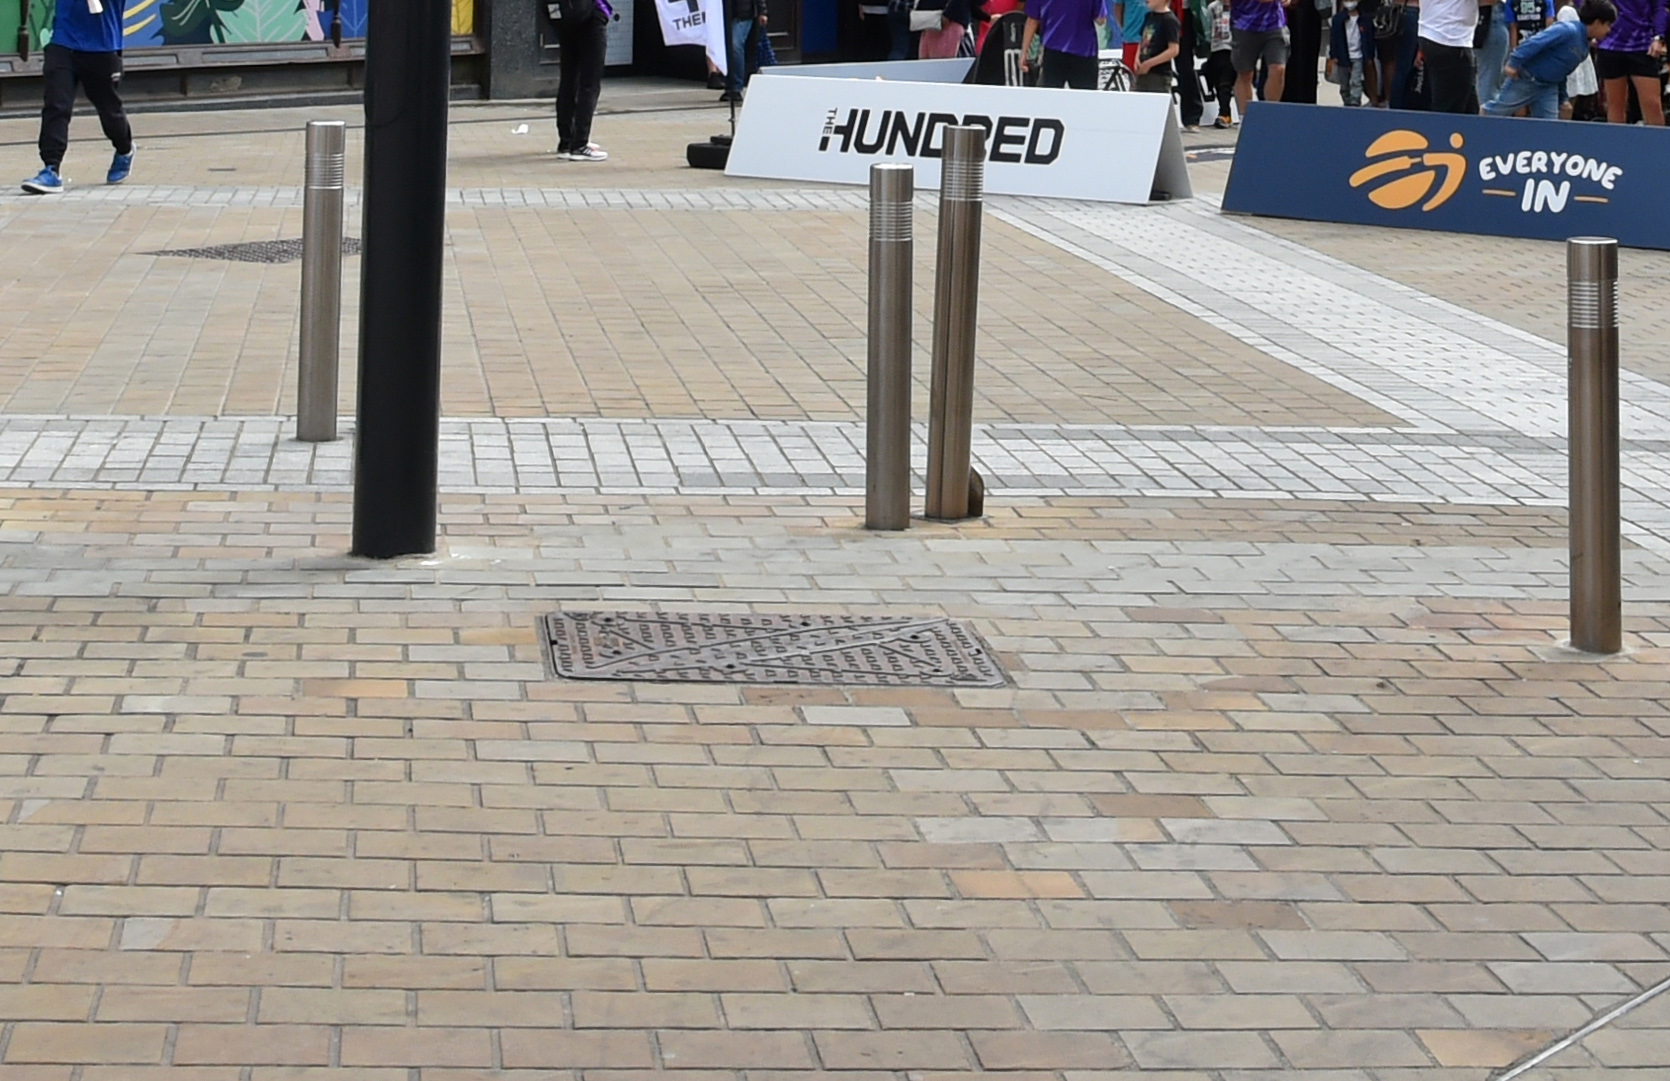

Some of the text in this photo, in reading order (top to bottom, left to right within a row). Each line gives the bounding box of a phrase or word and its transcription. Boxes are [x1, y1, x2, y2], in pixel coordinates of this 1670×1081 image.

[673, 11, 706, 31] THE
[820, 107, 837, 136] THE
[1479, 150, 1623, 190] EVERYONE
[1521, 178, 1571, 213] IN
